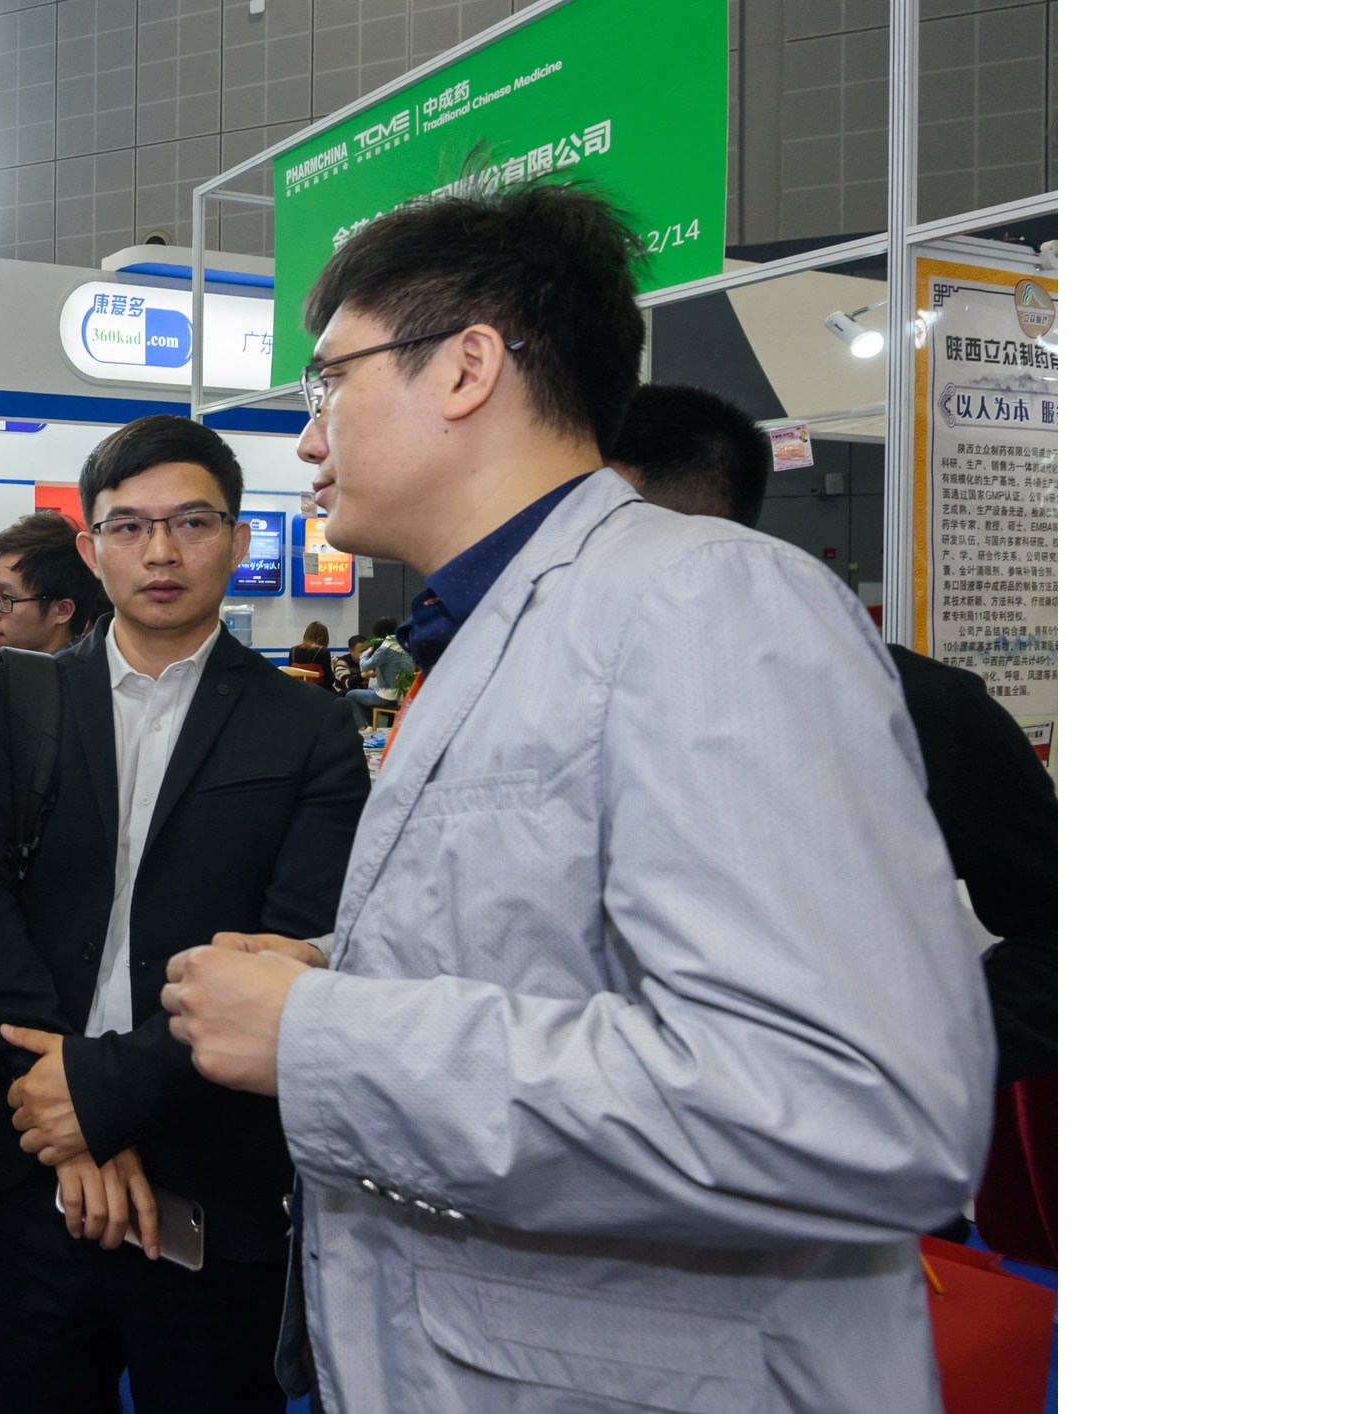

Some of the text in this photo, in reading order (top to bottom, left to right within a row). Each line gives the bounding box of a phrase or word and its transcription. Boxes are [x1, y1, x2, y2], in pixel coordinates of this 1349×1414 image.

[423, 60, 563, 133] Traditional Chinese Medicine
[423, 79, 470, 117] 中成药
[286, 141, 348, 186] PHARMCHINA
[93, 293, 145, 318] 康爱多
[956, 394, 1058, 424] 以人为本 服
